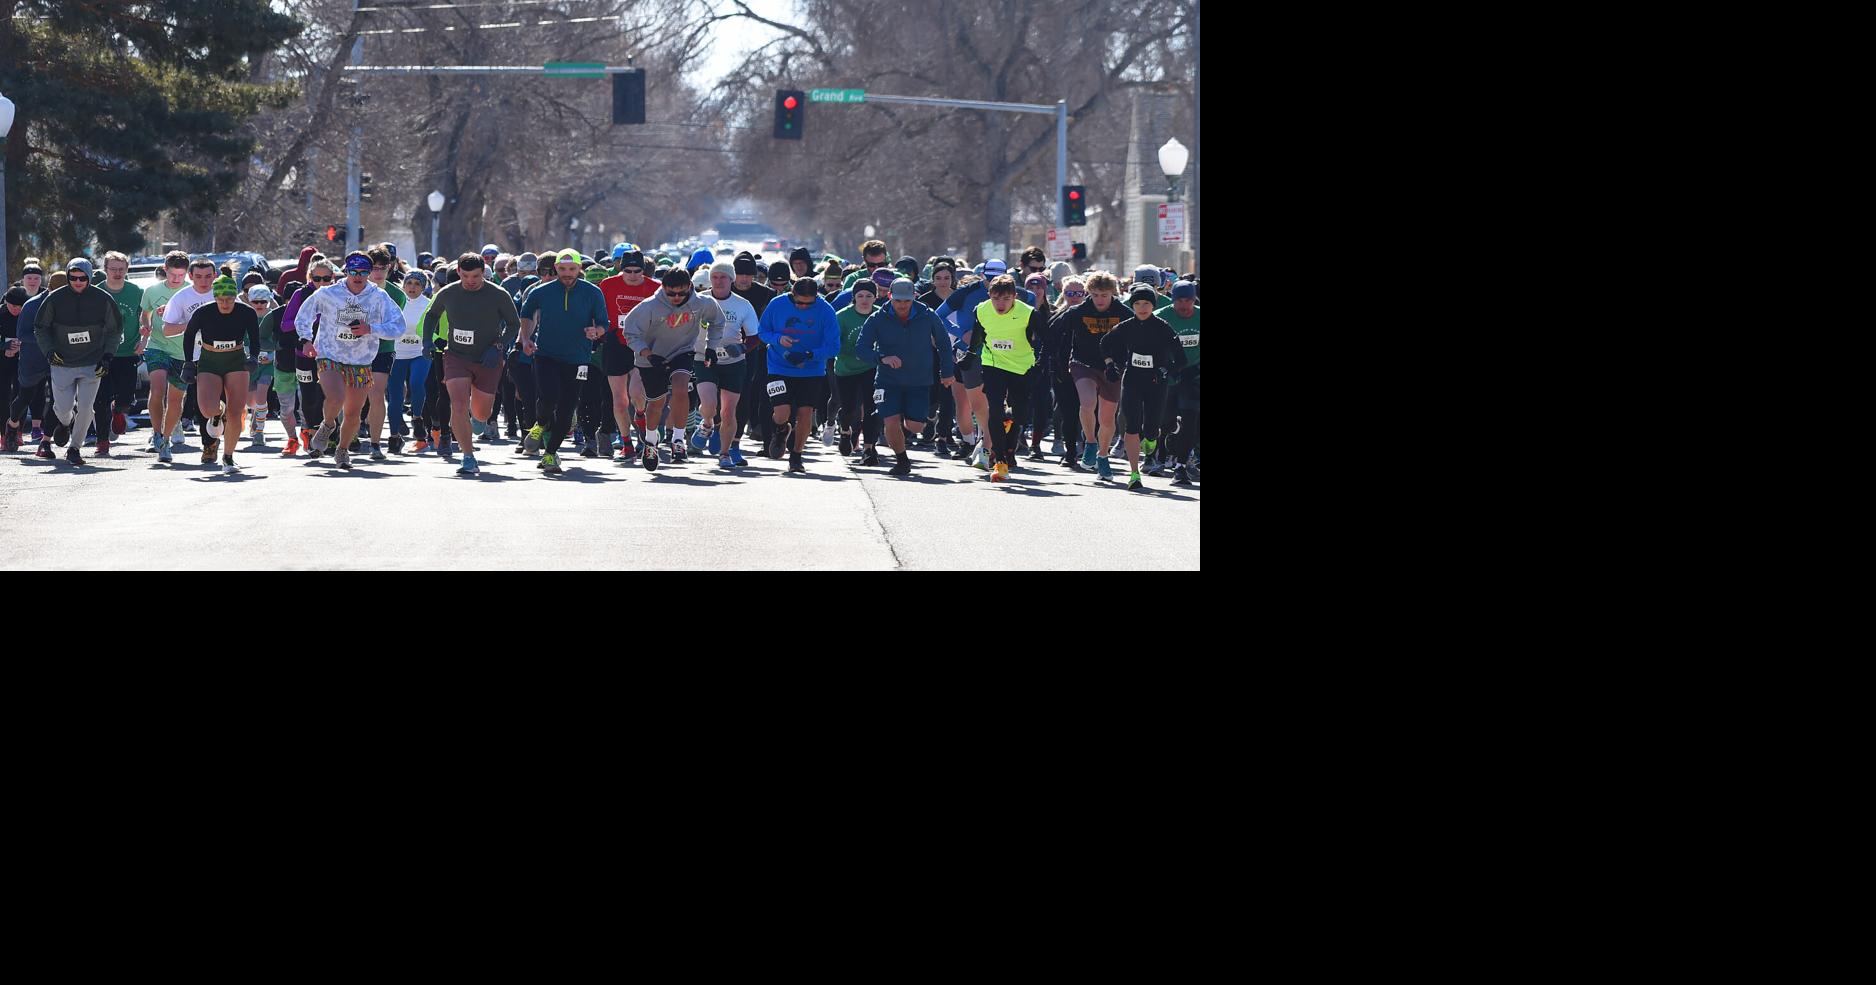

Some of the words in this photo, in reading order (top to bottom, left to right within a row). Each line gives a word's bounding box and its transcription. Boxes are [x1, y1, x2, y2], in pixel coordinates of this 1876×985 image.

[811, 89, 844, 102] Grand
[455, 335, 472, 343] 4567
[1132, 358, 1151, 366] 4661
